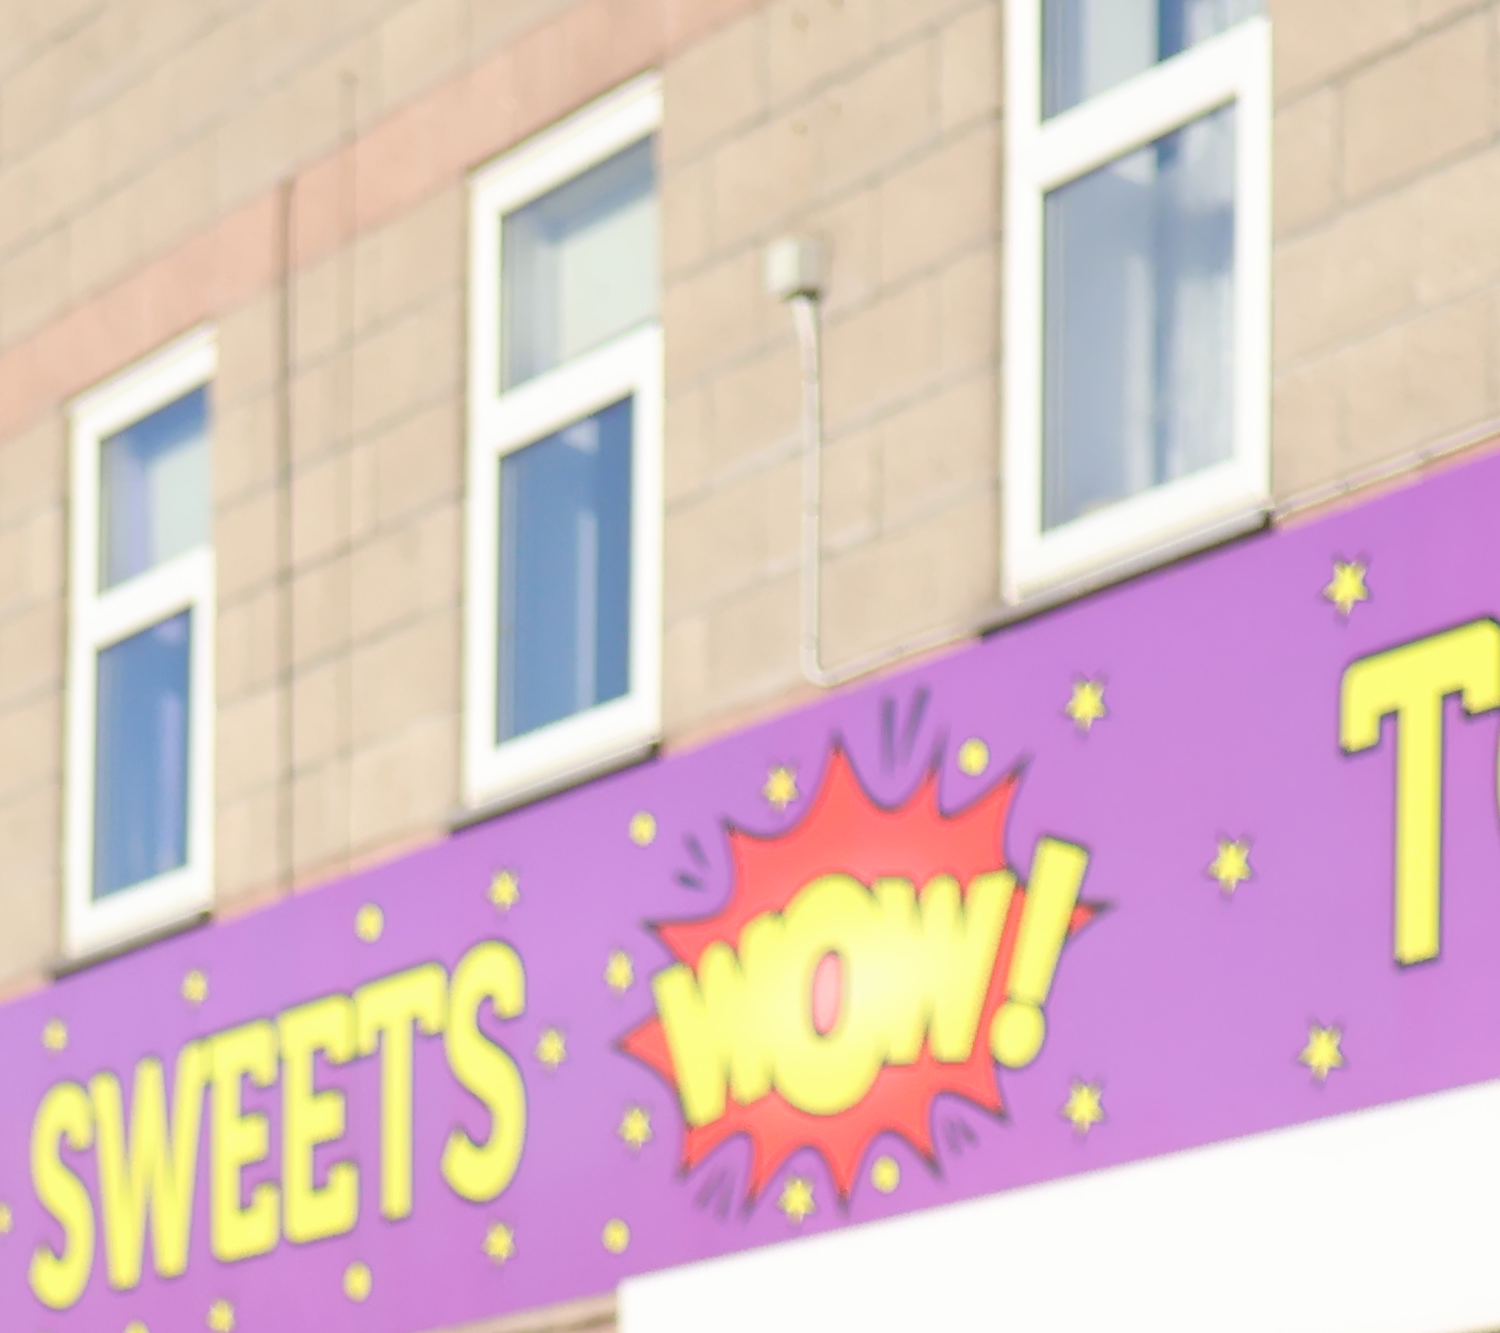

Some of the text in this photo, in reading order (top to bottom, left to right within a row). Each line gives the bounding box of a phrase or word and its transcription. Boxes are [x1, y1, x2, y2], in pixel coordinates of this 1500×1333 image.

[28, 614, 1500, 1311] SWEETS WOW! T
